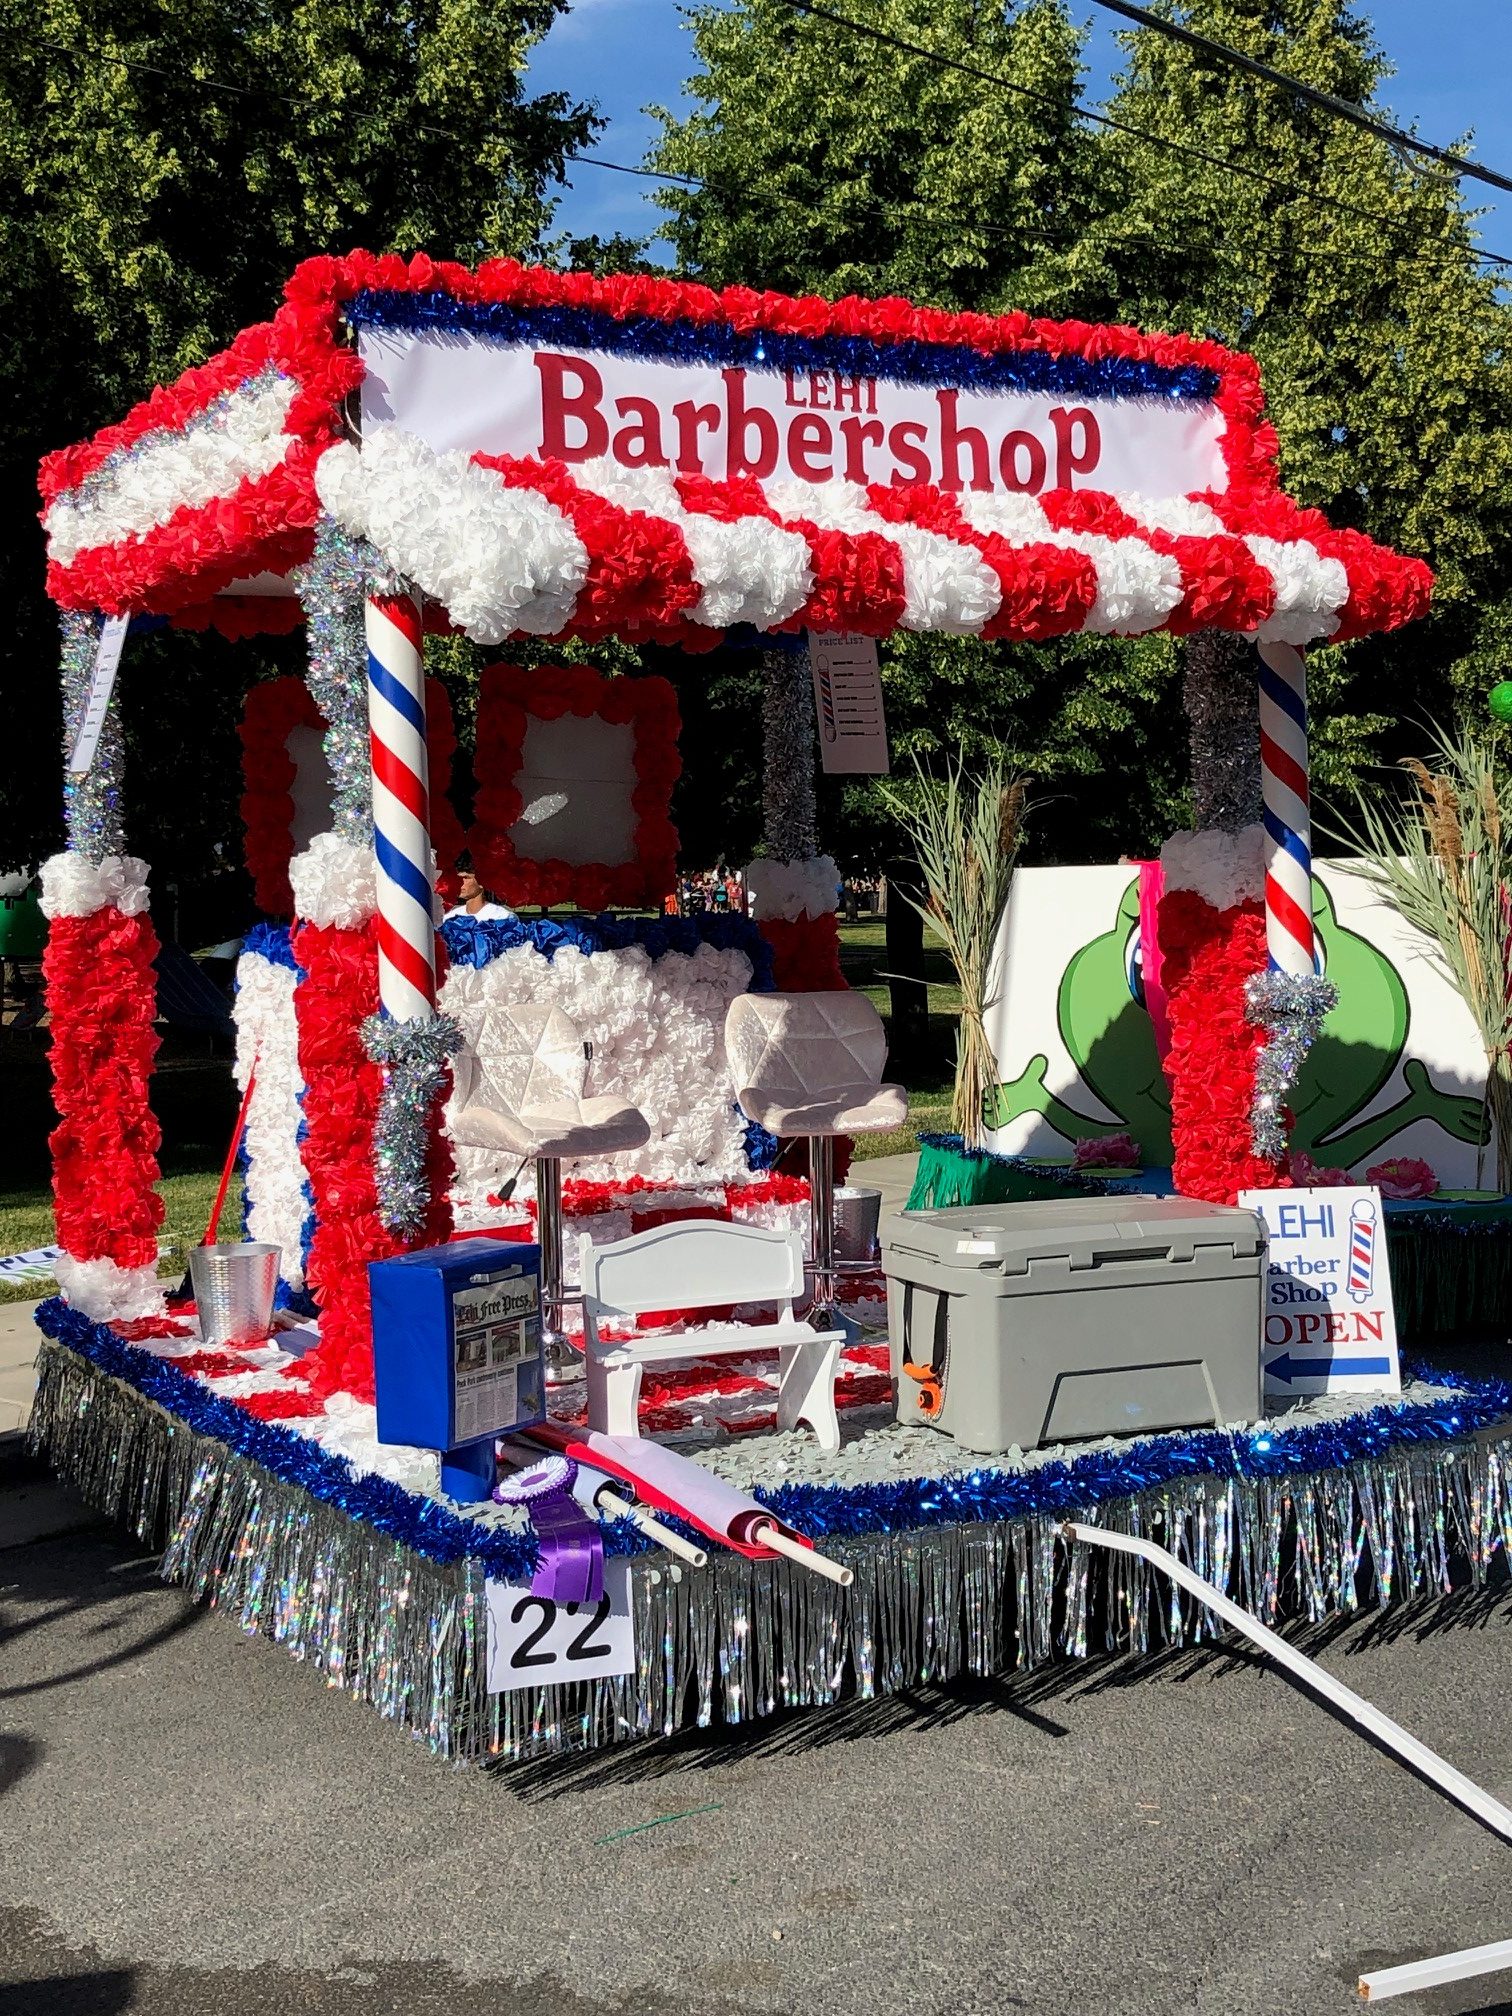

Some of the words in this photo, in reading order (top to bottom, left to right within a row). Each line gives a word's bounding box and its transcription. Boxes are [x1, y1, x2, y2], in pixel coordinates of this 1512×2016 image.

[785, 366, 878, 414] LEHI
[533, 352, 1101, 495] Barbershop
[818, 638, 843, 646] PRICE
[845, 637, 864, 645] LIST
[1269, 1254, 1340, 1275] arber
[1271, 1281, 1338, 1305] Shop
[480, 1300, 501, 1321] Free
[1264, 1311, 1385, 1345] OPEN
[510, 1590, 612, 1669] 22
